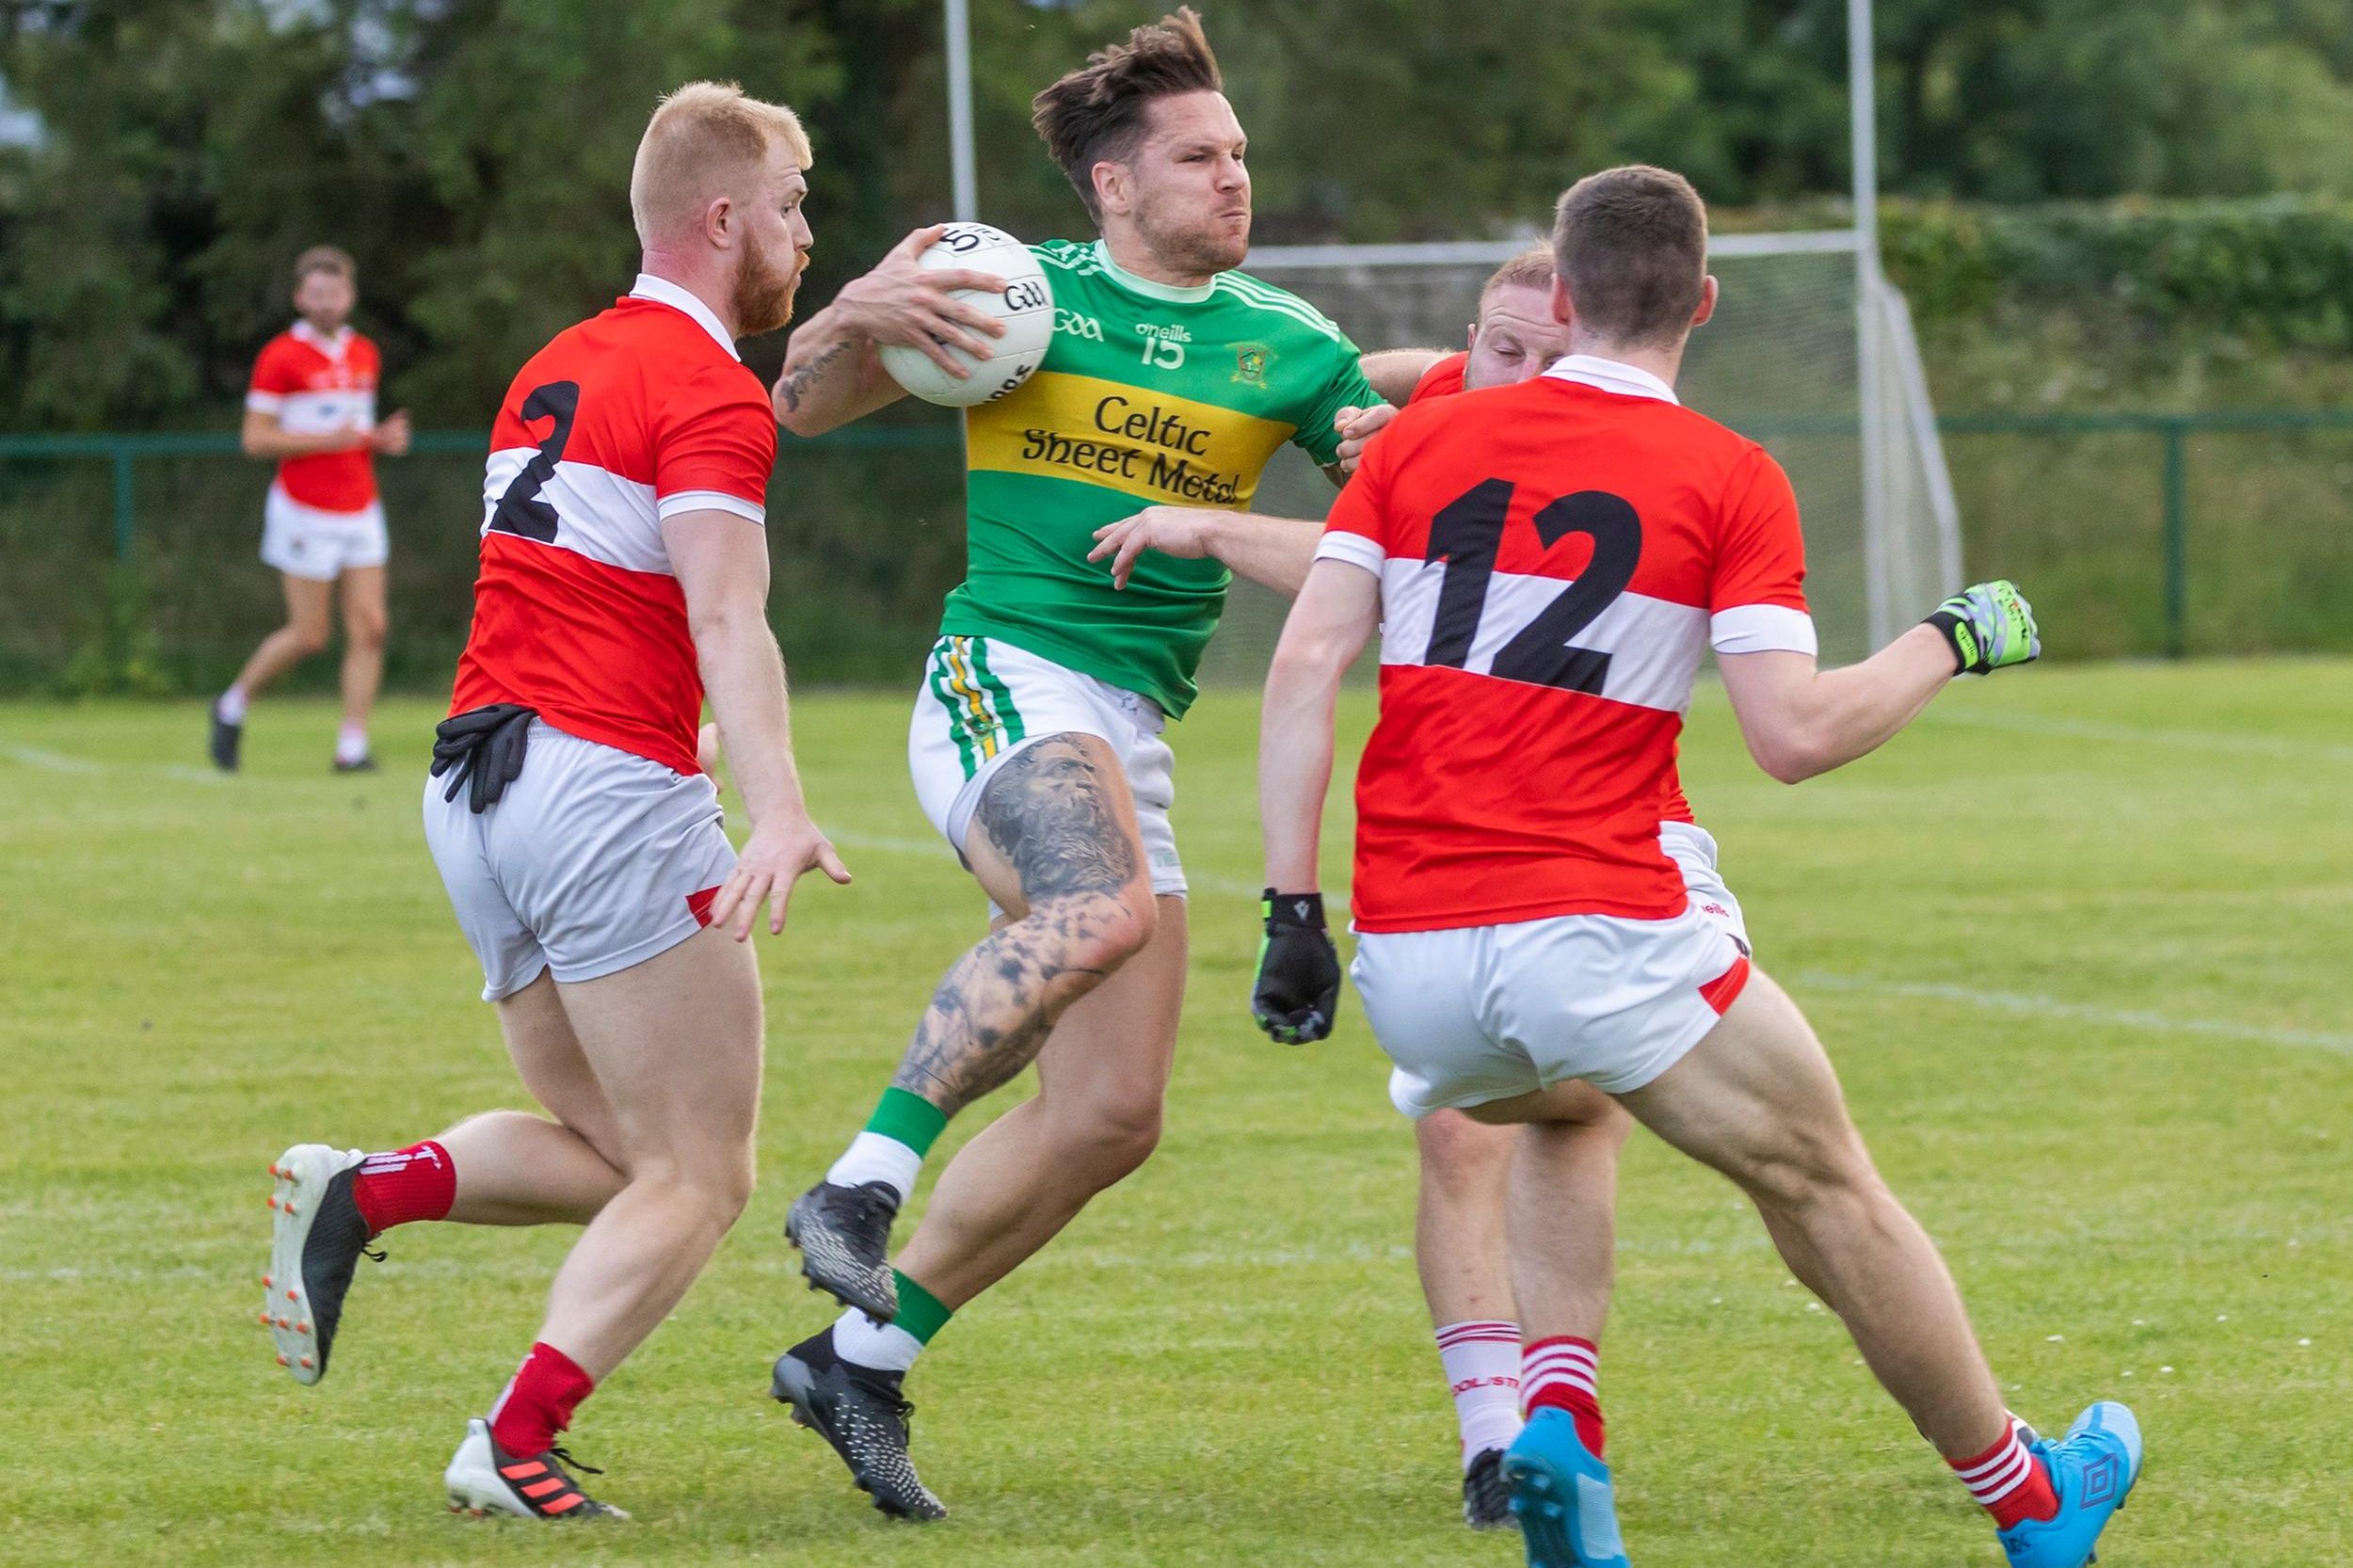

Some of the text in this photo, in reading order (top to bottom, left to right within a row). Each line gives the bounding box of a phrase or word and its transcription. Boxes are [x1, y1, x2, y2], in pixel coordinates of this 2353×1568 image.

[1142, 337, 1186, 370] 15
[487, 380, 581, 544] 2
[1095, 395, 1211, 456] Celtic
[1022, 428, 1241, 505] Sheet Metal
[1423, 477, 1642, 696] 12
